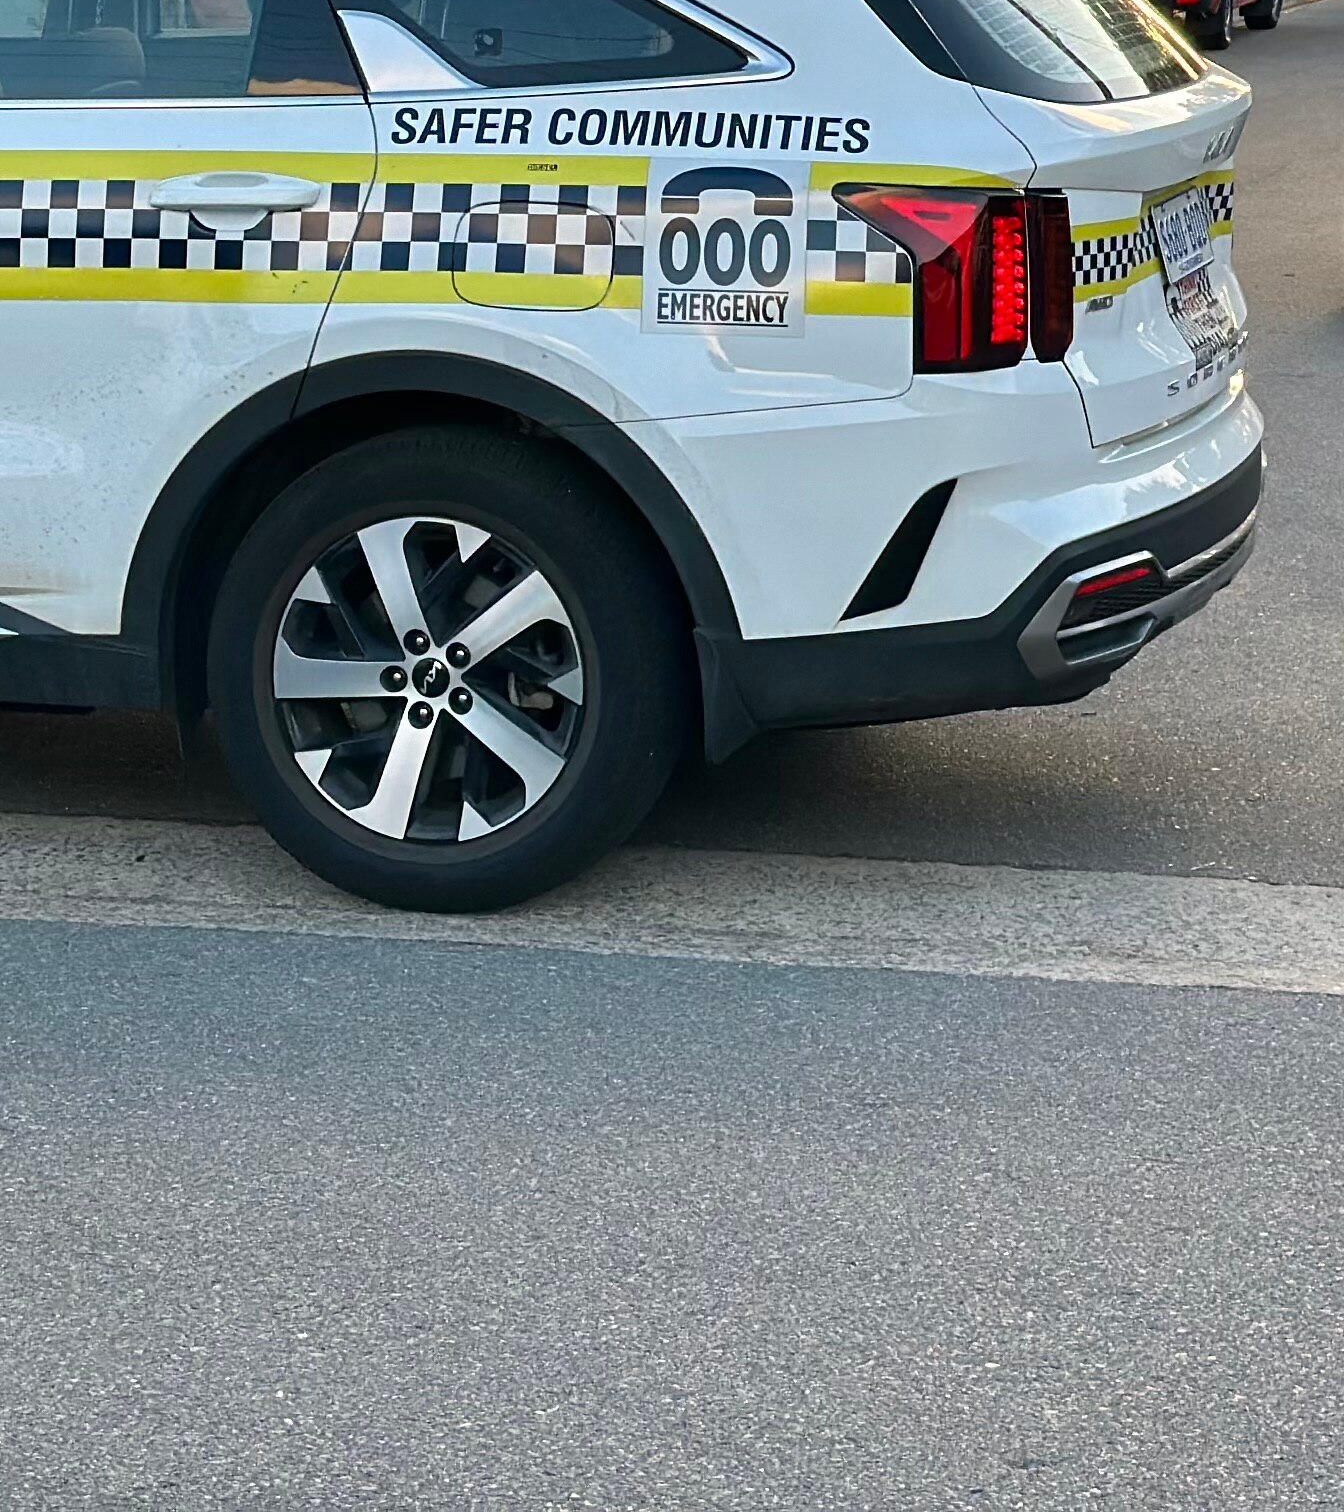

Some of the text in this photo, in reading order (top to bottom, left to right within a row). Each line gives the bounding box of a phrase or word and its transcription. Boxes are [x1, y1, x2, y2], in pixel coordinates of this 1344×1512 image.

[391, 108, 871, 154] SAFER COMMUNITIES
[659, 217, 791, 287] 000
[657, 291, 789, 324] EMERGENCY
